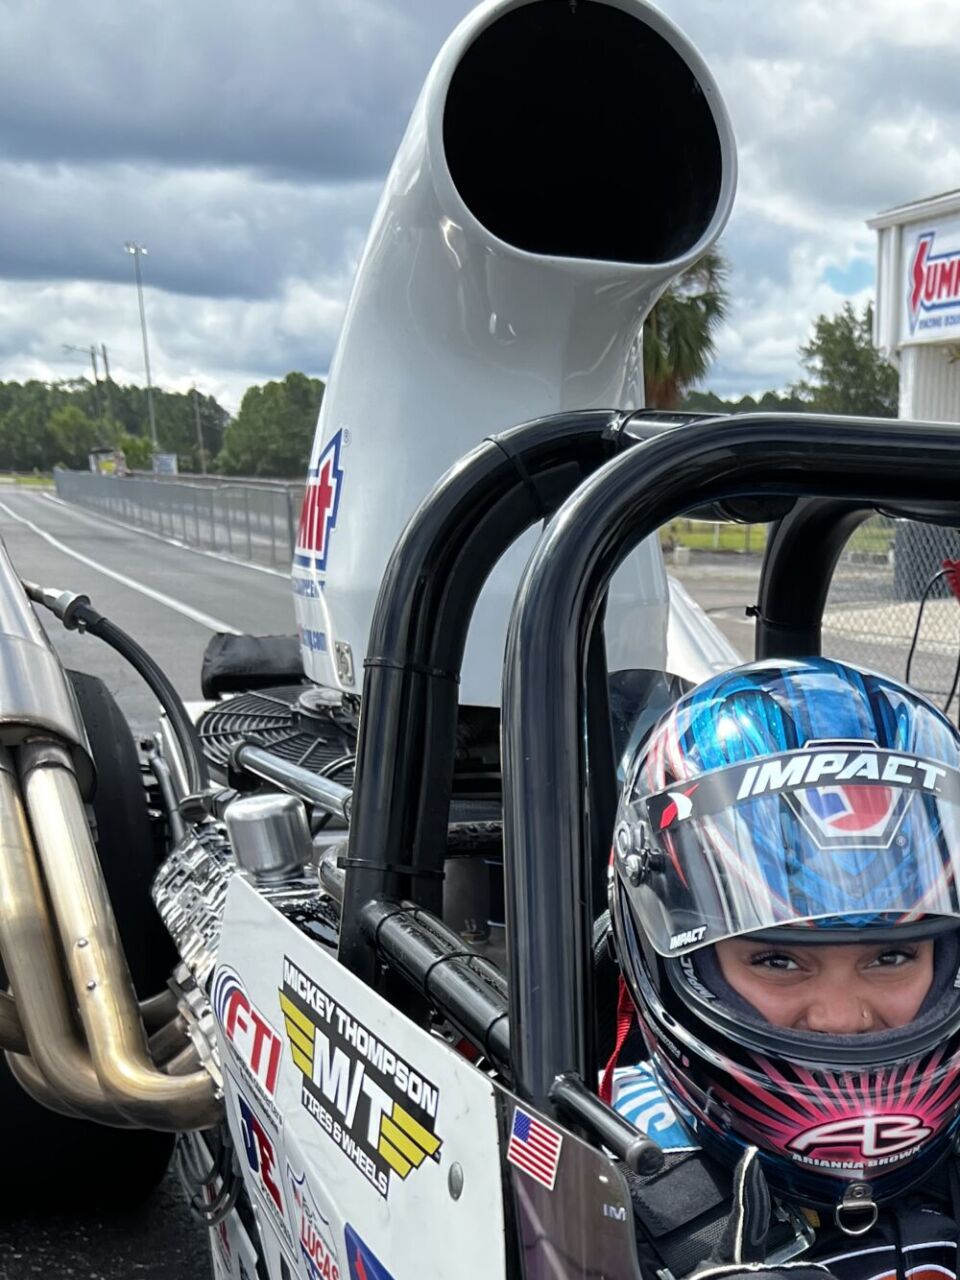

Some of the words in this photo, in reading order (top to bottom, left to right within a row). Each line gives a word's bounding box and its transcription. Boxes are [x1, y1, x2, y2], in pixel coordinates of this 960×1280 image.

[736, 752, 947, 801] IMPACT
[669, 925, 708, 951] IMPACT
[225, 989, 283, 1097] FTI
[283, 960, 335, 1024] MICKEY
[335, 1010, 439, 1119] THOMPSON
[302, 1086, 334, 1133] TIRES
[341, 1131, 389, 1197] WHEELS
[792, 1153, 865, 1170] ARIANNA
[866, 1145, 922, 1168] BROWN
